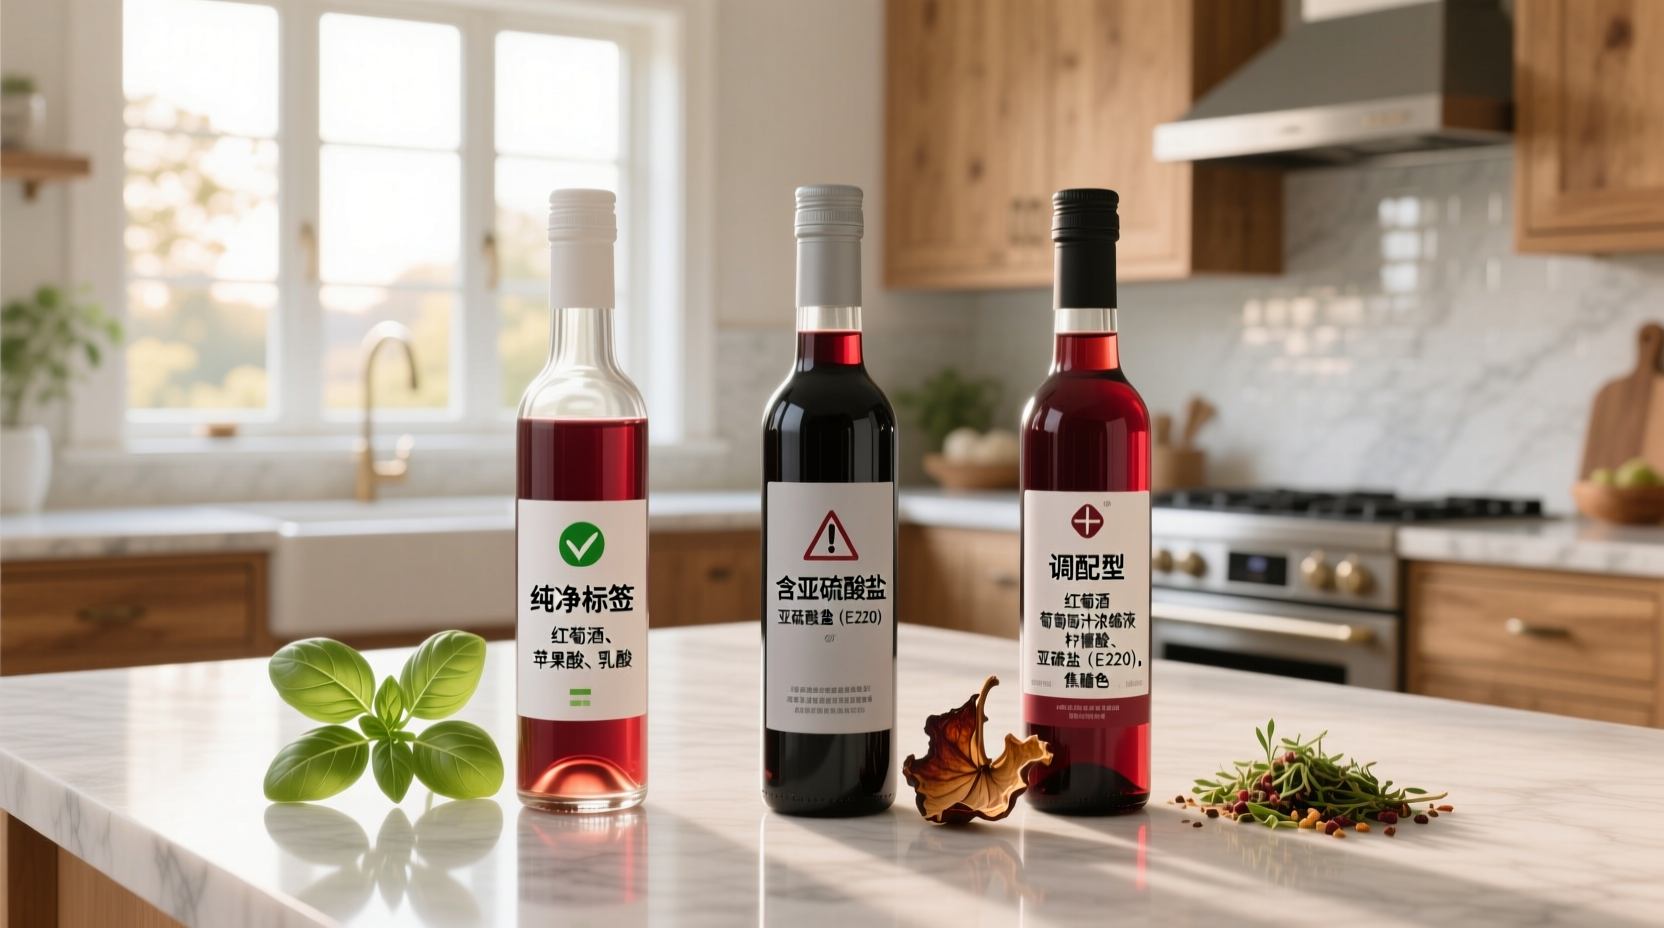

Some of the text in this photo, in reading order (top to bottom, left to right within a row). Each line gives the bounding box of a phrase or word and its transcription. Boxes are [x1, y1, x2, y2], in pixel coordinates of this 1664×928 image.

[1048, 553, 1125, 581] 调配型
[530, 584, 635, 613] 纯净标签
[776, 574, 887, 601] 含亚硫酸盐
